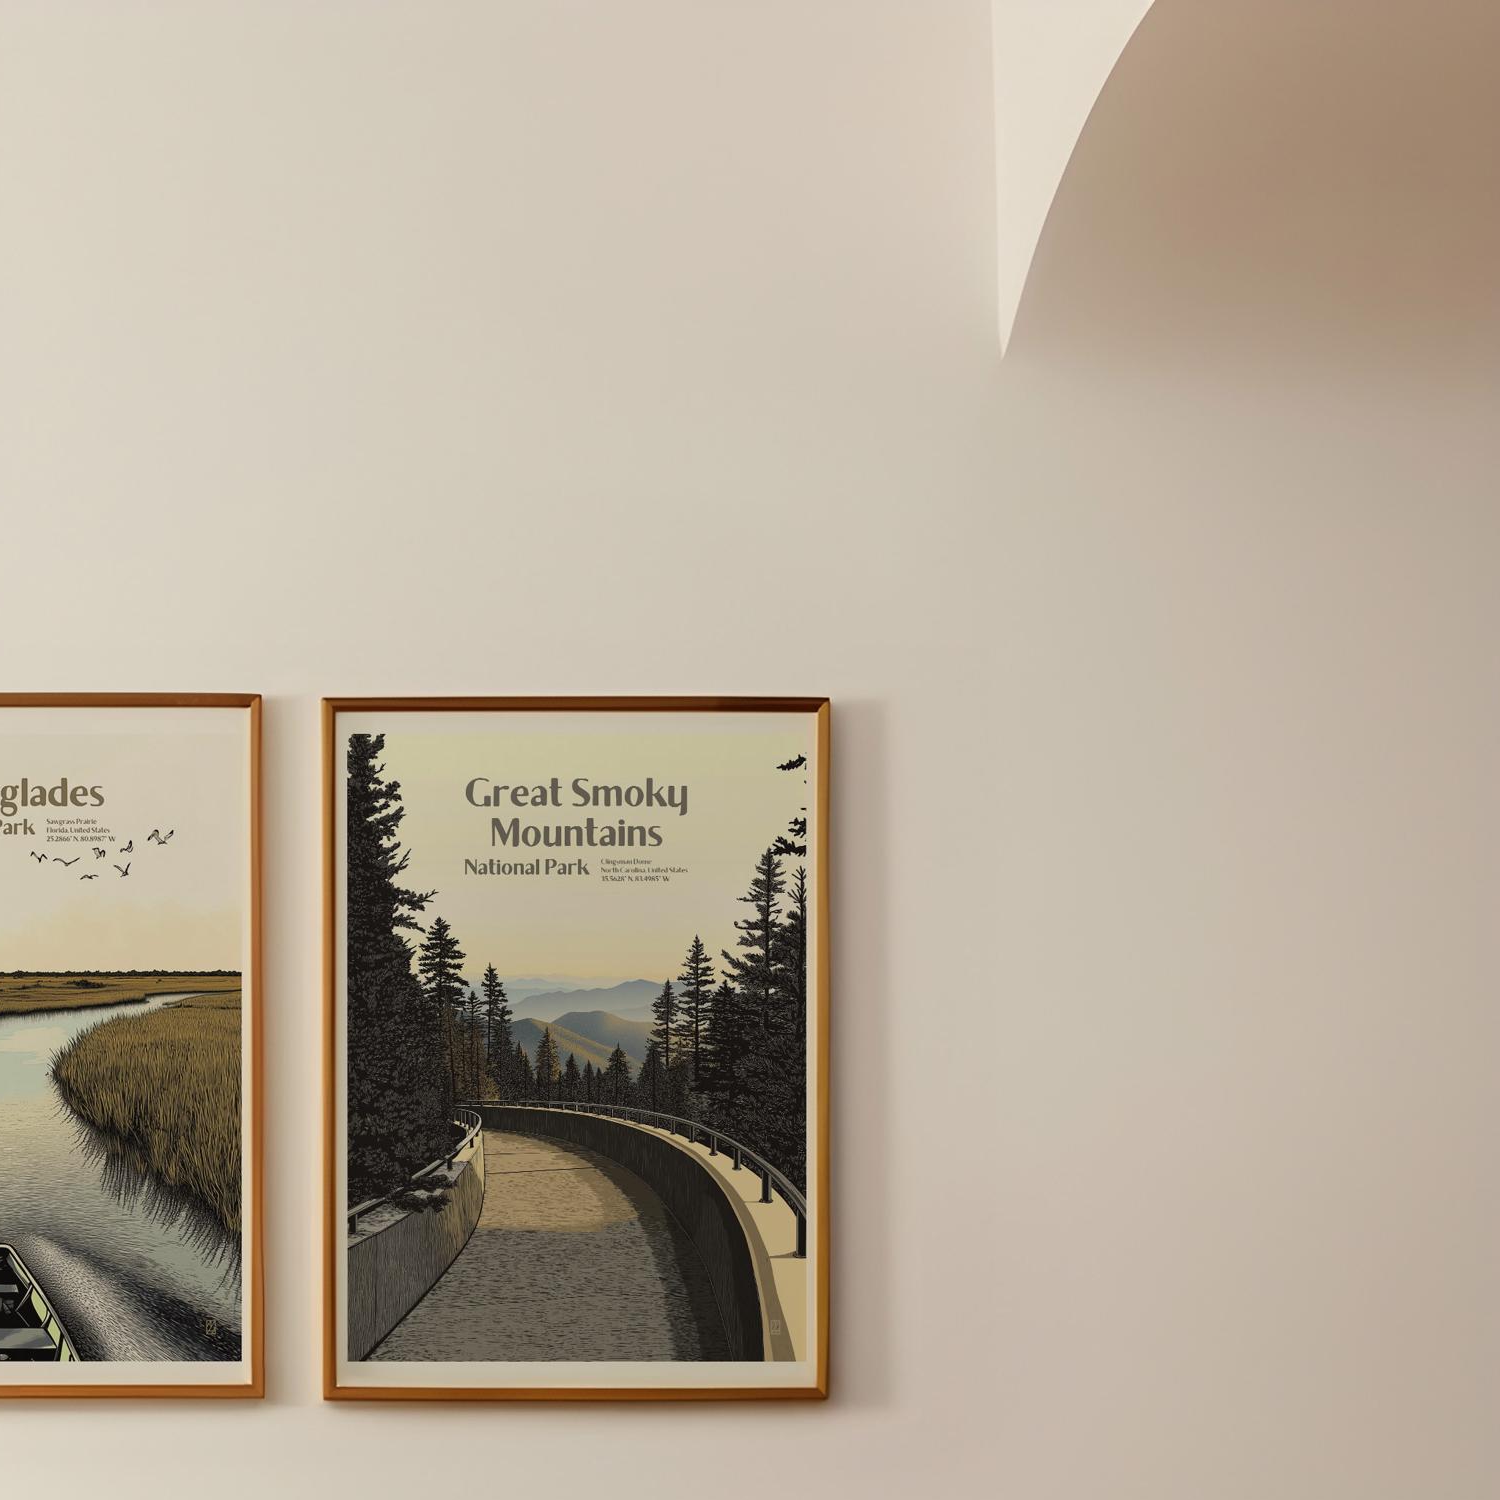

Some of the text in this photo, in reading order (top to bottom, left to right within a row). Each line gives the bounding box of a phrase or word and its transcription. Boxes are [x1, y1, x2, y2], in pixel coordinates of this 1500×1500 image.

[466, 778, 687, 816] Great Smoky
[492, 818, 663, 847] Mountains
[465, 859, 590, 875] National Park
